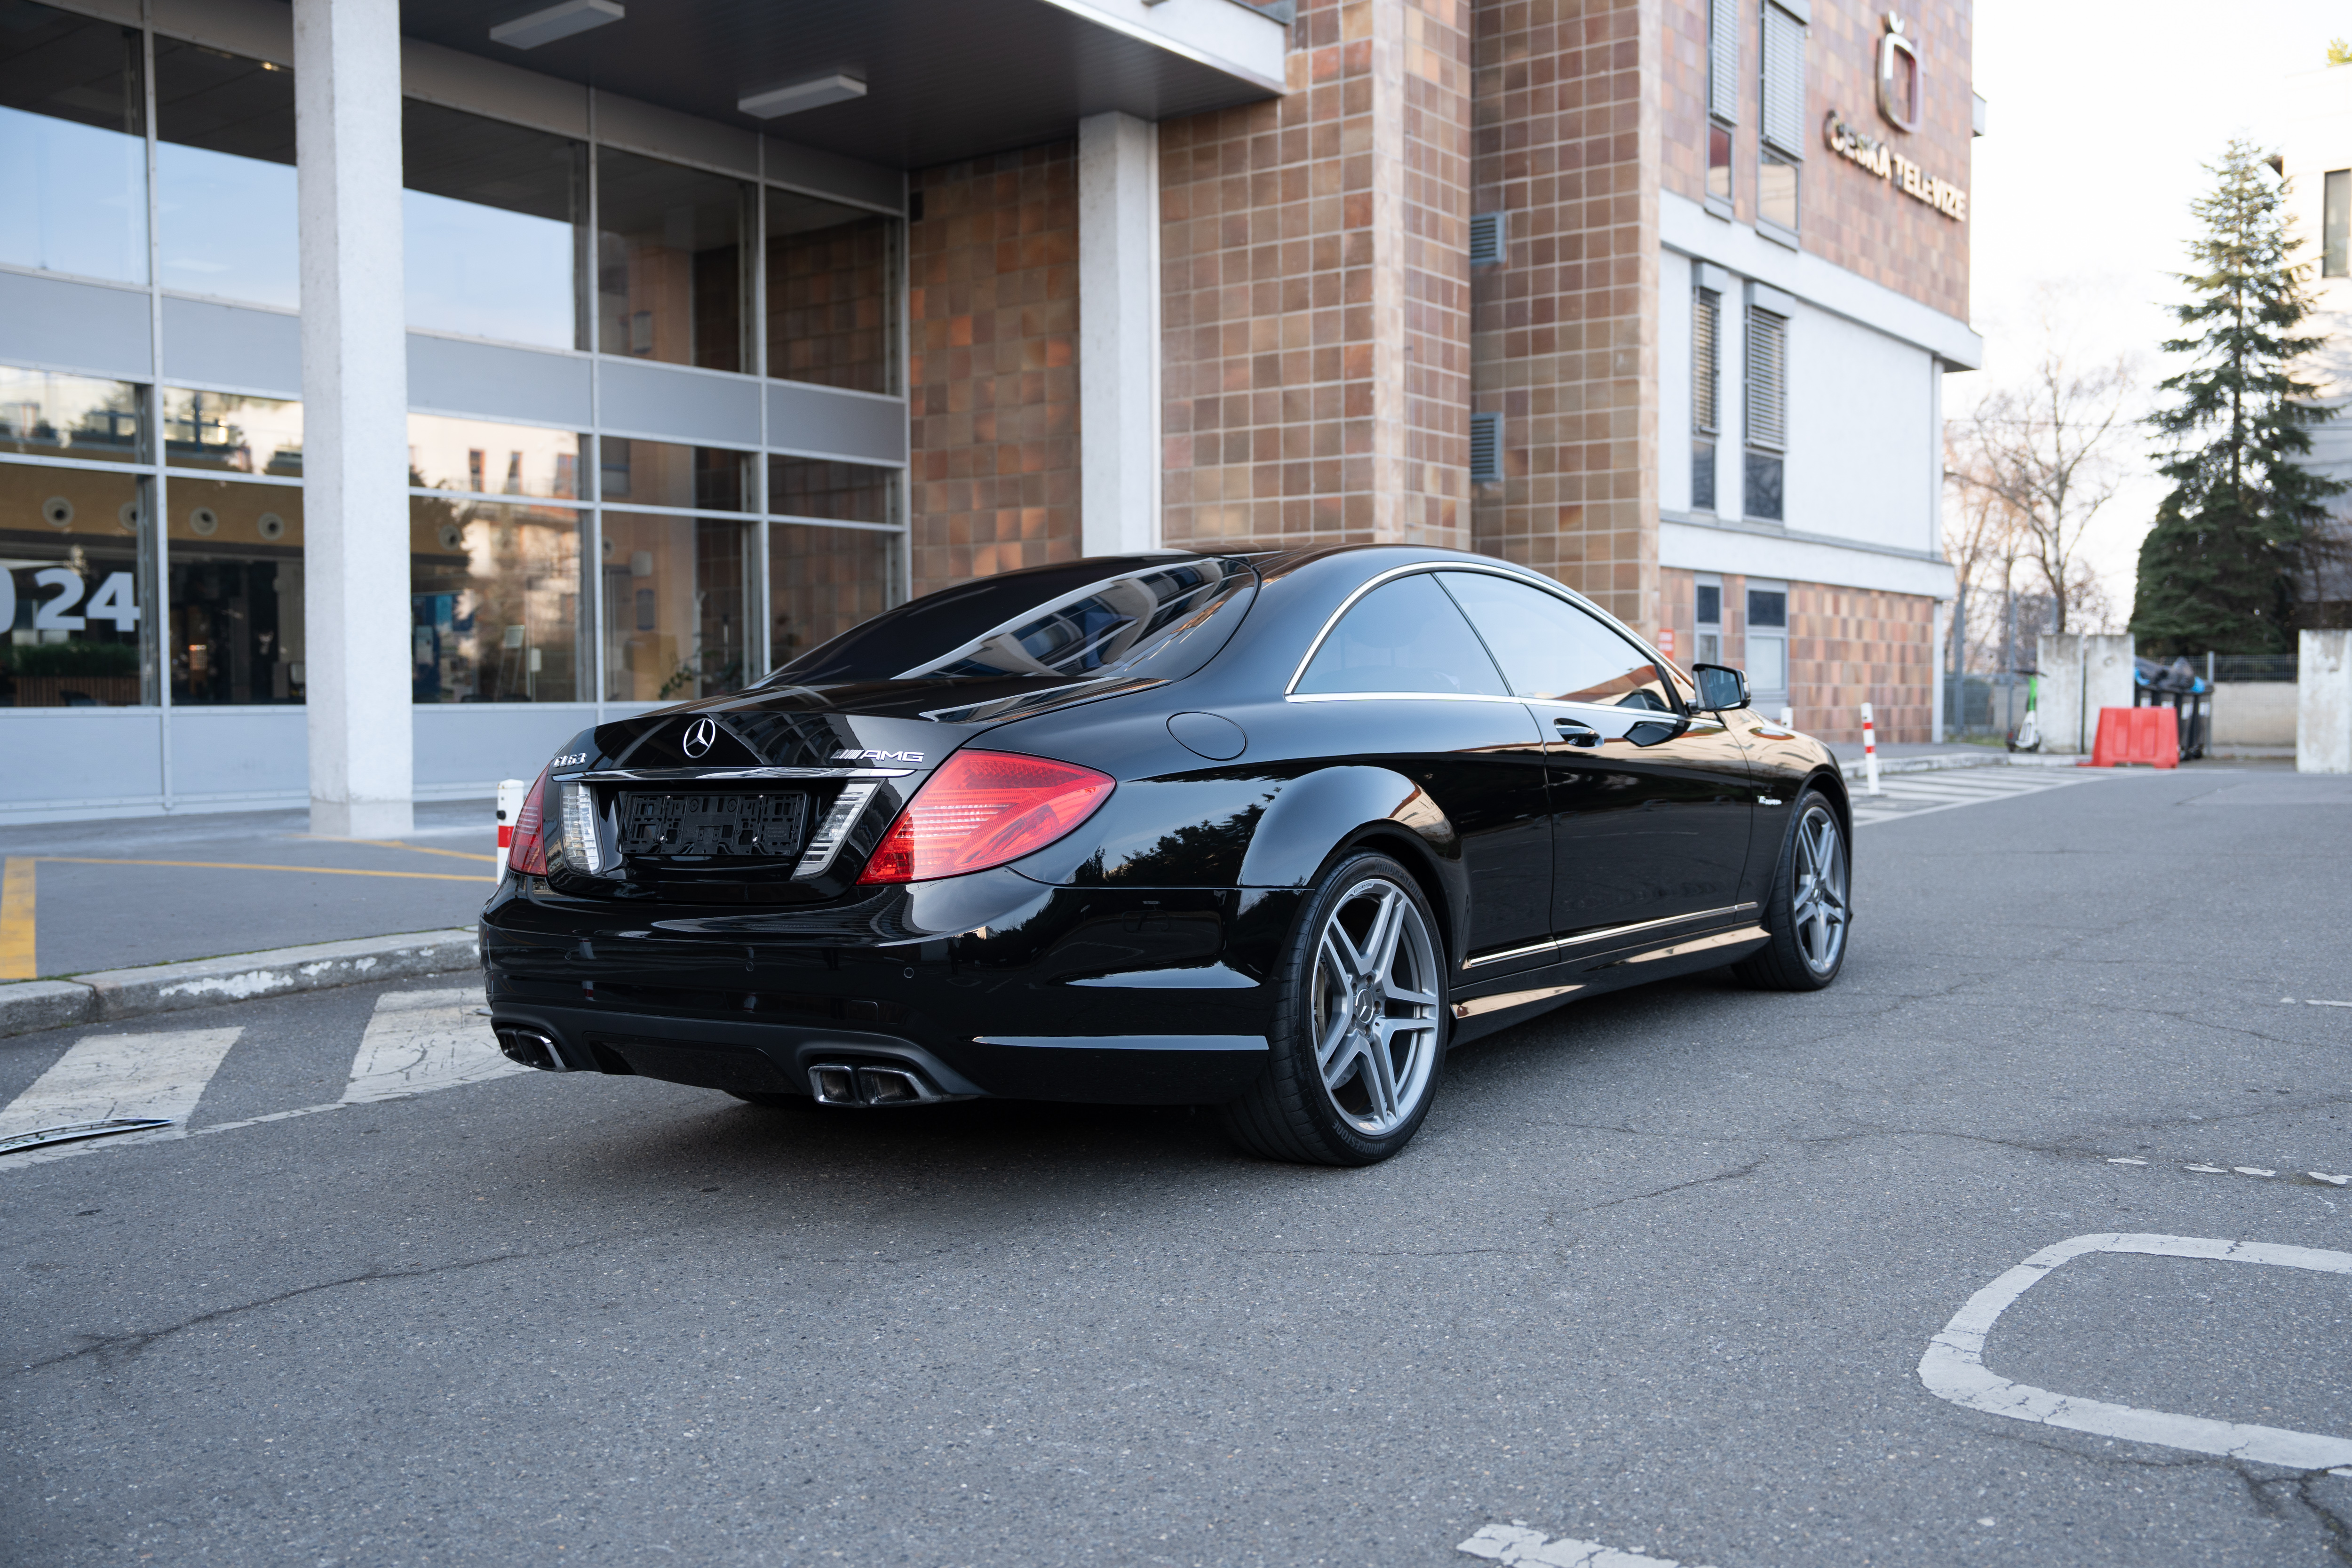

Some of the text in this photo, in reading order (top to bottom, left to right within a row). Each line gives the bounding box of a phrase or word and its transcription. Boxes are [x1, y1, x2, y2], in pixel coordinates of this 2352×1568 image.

[1894, 152, 1966, 222] TELEVIZE
[858, 750, 924, 762] AMG
[1375, 859, 1424, 902] BRIDGESTONE
[1332, 1119, 1386, 1154] BRIDGESTONE
